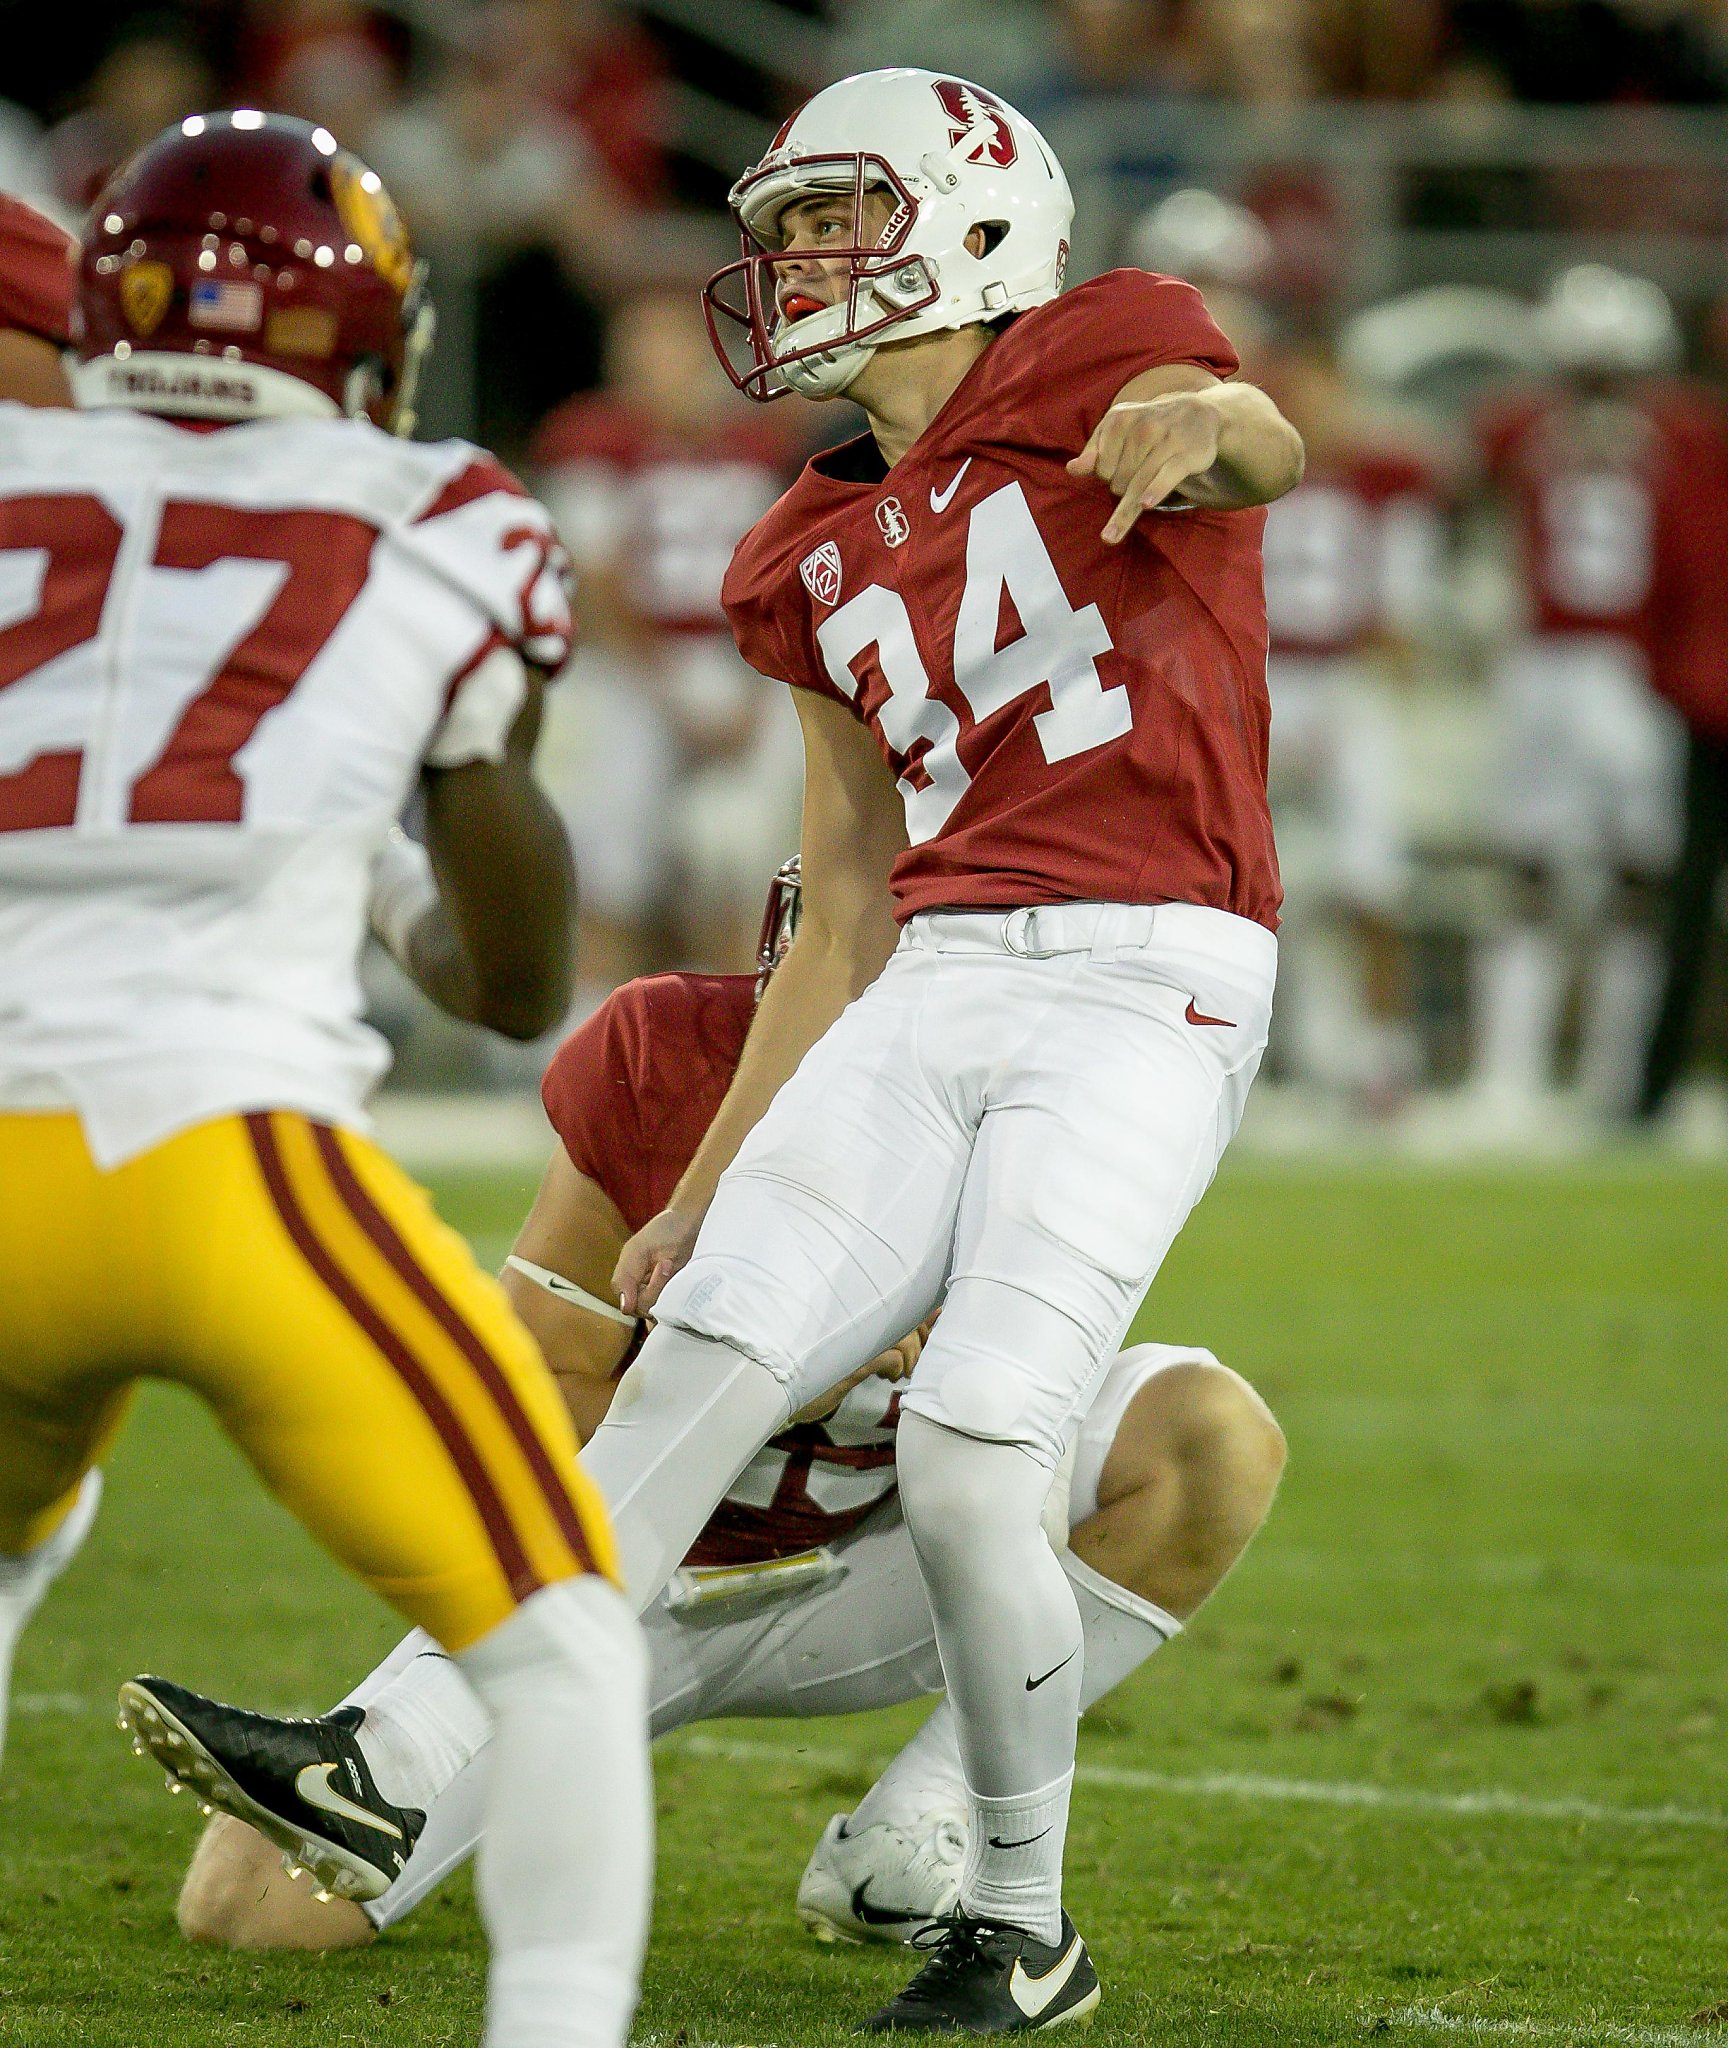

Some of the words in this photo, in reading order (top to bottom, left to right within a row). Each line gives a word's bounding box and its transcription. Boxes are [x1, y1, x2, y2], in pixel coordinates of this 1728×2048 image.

[877, 198, 918, 250] Ridde
[0, 493, 383, 833] 27
[816, 569, 837, 598] 12
[816, 480, 1133, 847] 34
